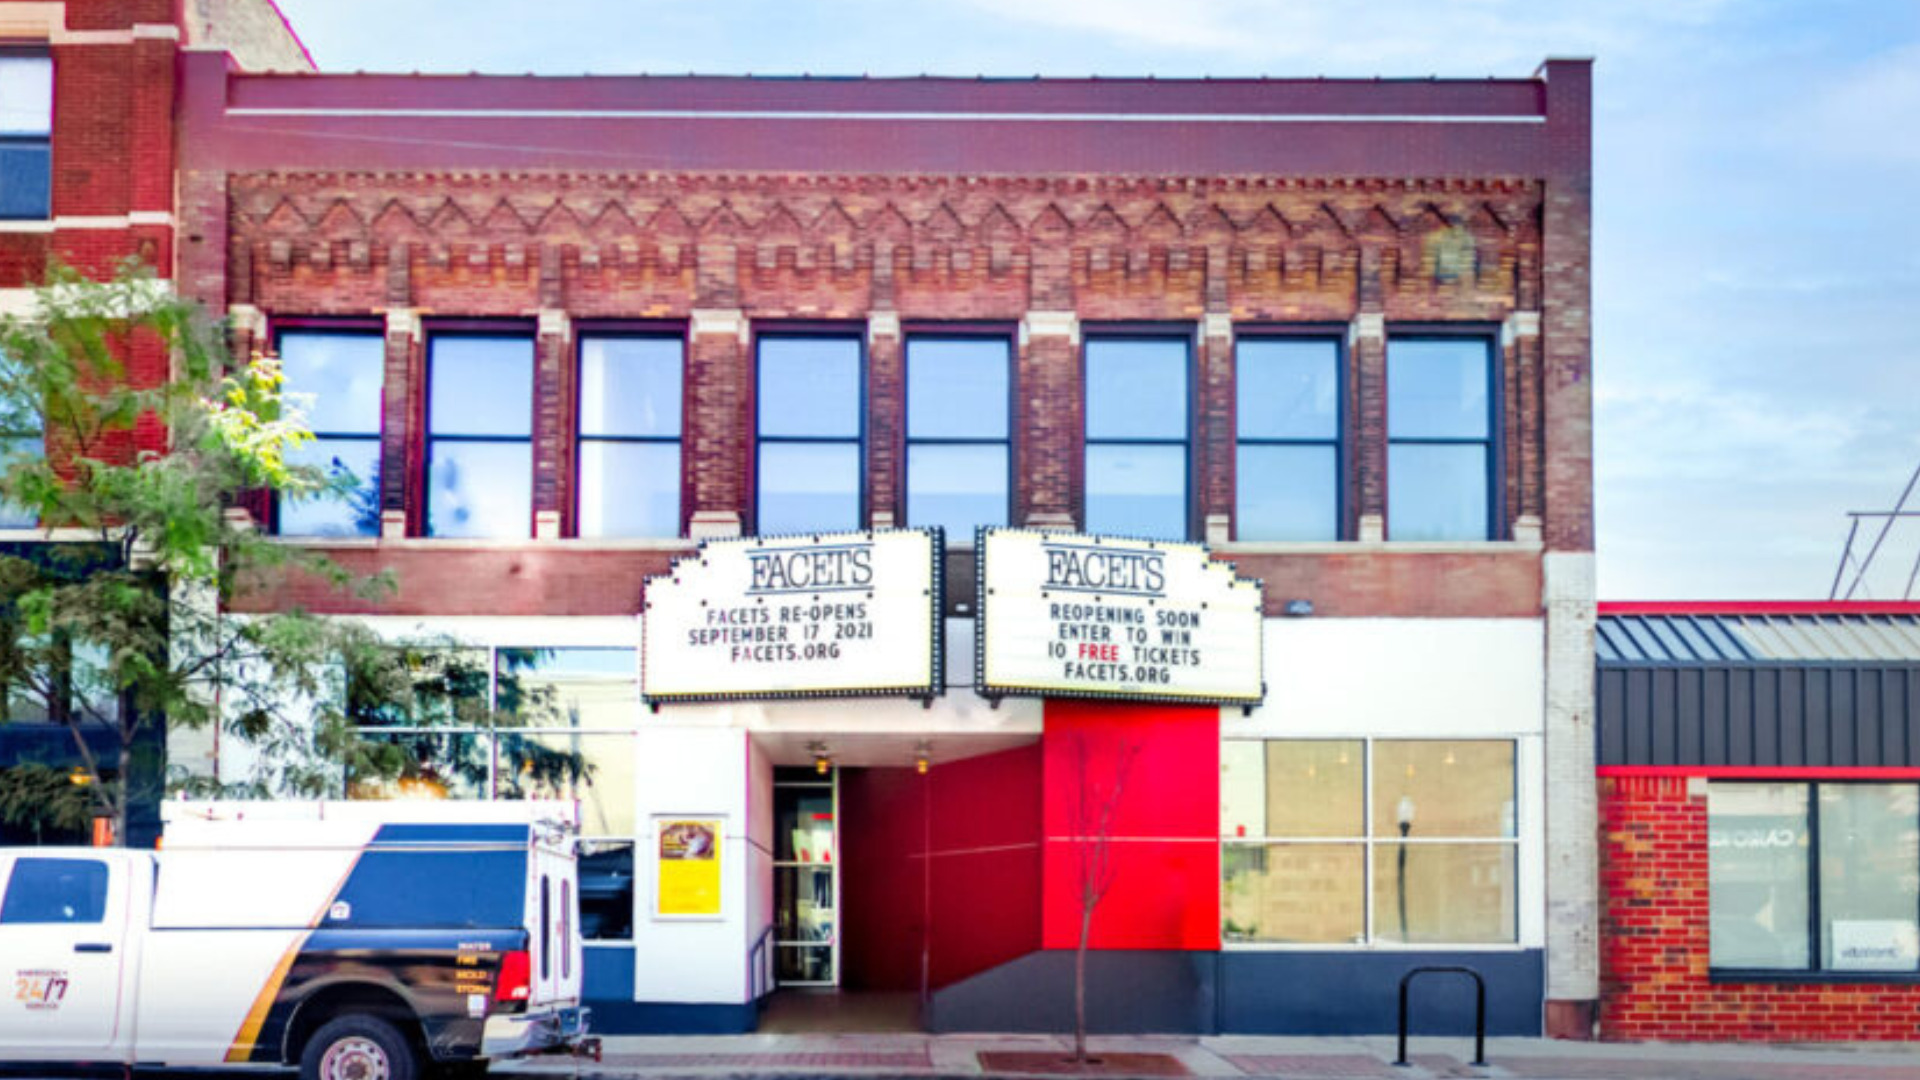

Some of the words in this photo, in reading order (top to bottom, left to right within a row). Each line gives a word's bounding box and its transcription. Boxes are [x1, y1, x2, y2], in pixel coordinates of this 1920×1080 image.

[751, 549, 873, 589] FACETS
[1046, 549, 1165, 592] FACETS
[707, 607, 770, 625] FACETS
[780, 603, 867, 622] RE-OPENS
[1050, 603, 1145, 624] REOPENING
[1157, 610, 1200, 628] SOON
[688, 627, 788, 645] SEPTEMBER
[803, 625, 819, 640] 17
[835, 623, 873, 640] 2021
[1059, 623, 1111, 641] ENTER
[1127, 626, 1147, 643] TO
[1161, 629, 1191, 646] WIN
[731, 643, 840, 662] FACETS.ORG
[1078, 643, 1119, 662] FREE
[1133, 646, 1200, 666] TICKETS
[1064, 662, 1170, 684] FACETS.ORG
[15, 978, 68, 1002] 24/7
